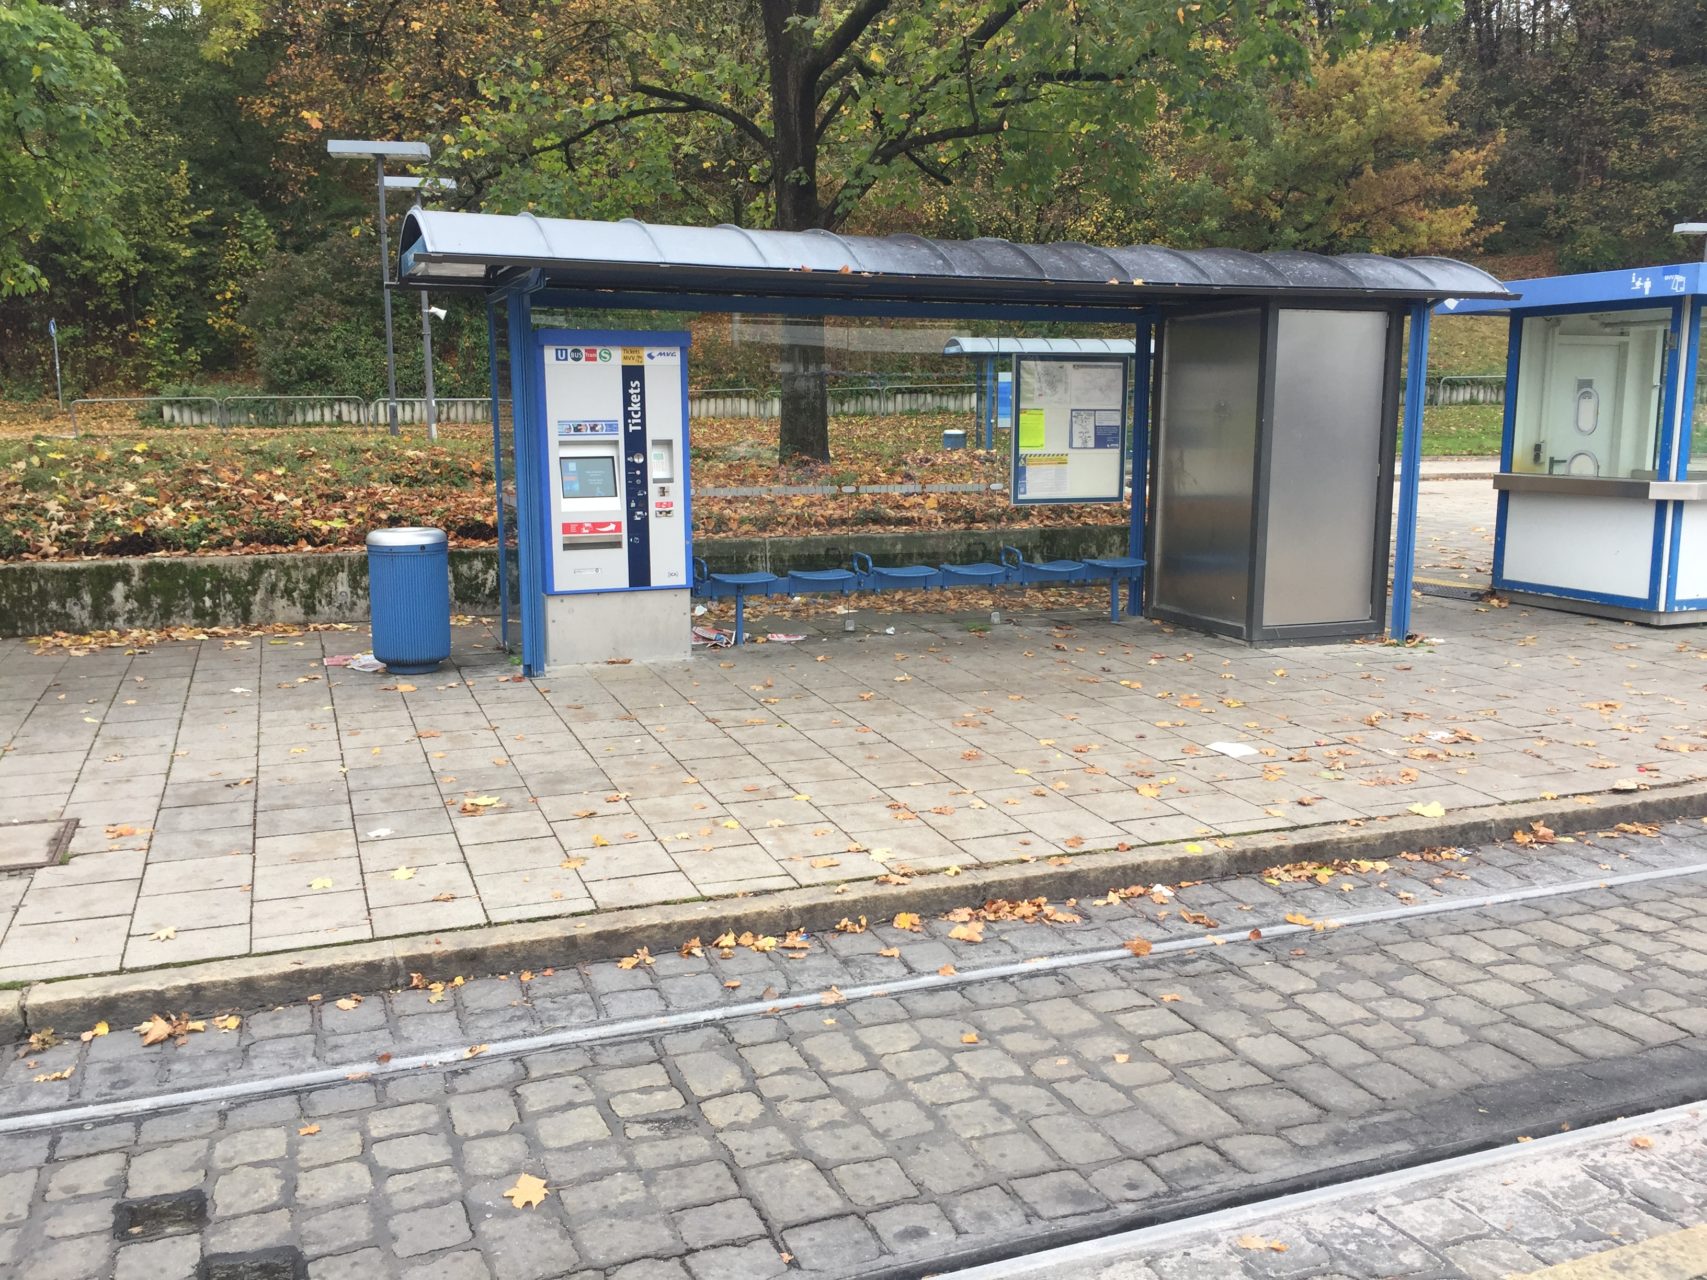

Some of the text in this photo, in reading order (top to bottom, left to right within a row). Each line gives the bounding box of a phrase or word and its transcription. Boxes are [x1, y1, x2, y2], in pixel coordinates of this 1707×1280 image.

[557, 349, 566, 360] U
[570, 351, 583, 359] BUS
[600, 349, 611, 361] S
[627, 380, 641, 433] Tickets
